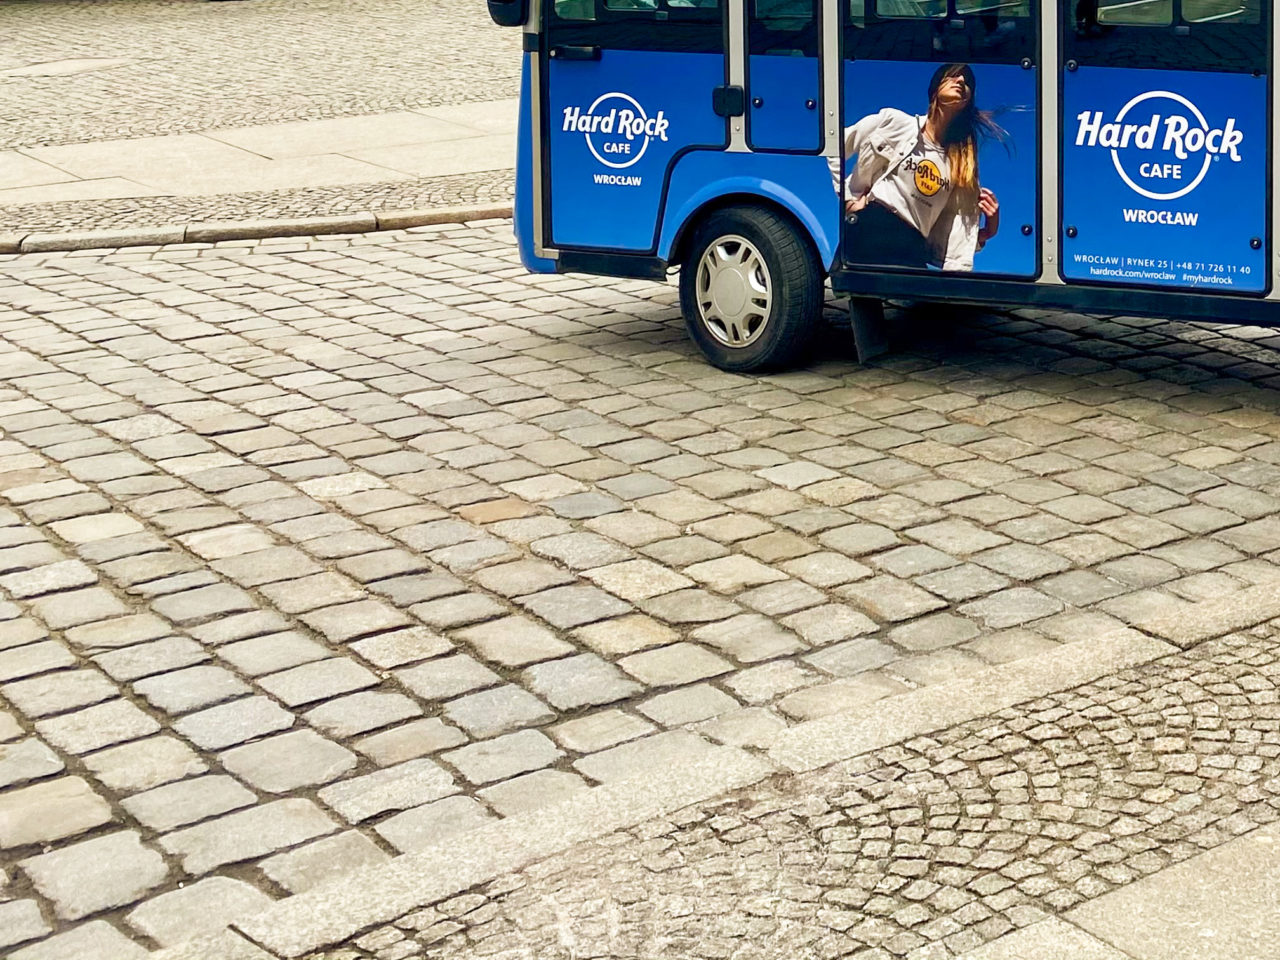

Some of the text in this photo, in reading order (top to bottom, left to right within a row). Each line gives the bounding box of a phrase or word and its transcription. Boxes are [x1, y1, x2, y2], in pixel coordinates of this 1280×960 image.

[562, 106, 670, 142] Hard Rock
[1075, 110, 1244, 162] Hard Rock
[603, 142, 631, 154] CAFE
[593, 174, 642, 186] WROCŁAW
[1139, 163, 1182, 179] CAFE
[1122, 208, 1199, 227] WROCŁAW
[1073, 254, 1119, 265] WROCŁAW
[1127, 257, 1155, 268] RYNEK
[1157, 260, 1168, 269] 25
[1176, 262, 1192, 270] +48
[1195, 263, 1205, 271] 71
[1208, 263, 1224, 273] 726
[1227, 265, 1237, 273] 11
[1239, 266, 1251, 275] 40
[1090, 266, 1233, 285] hardrock.com/wroclaw #myhardrock
